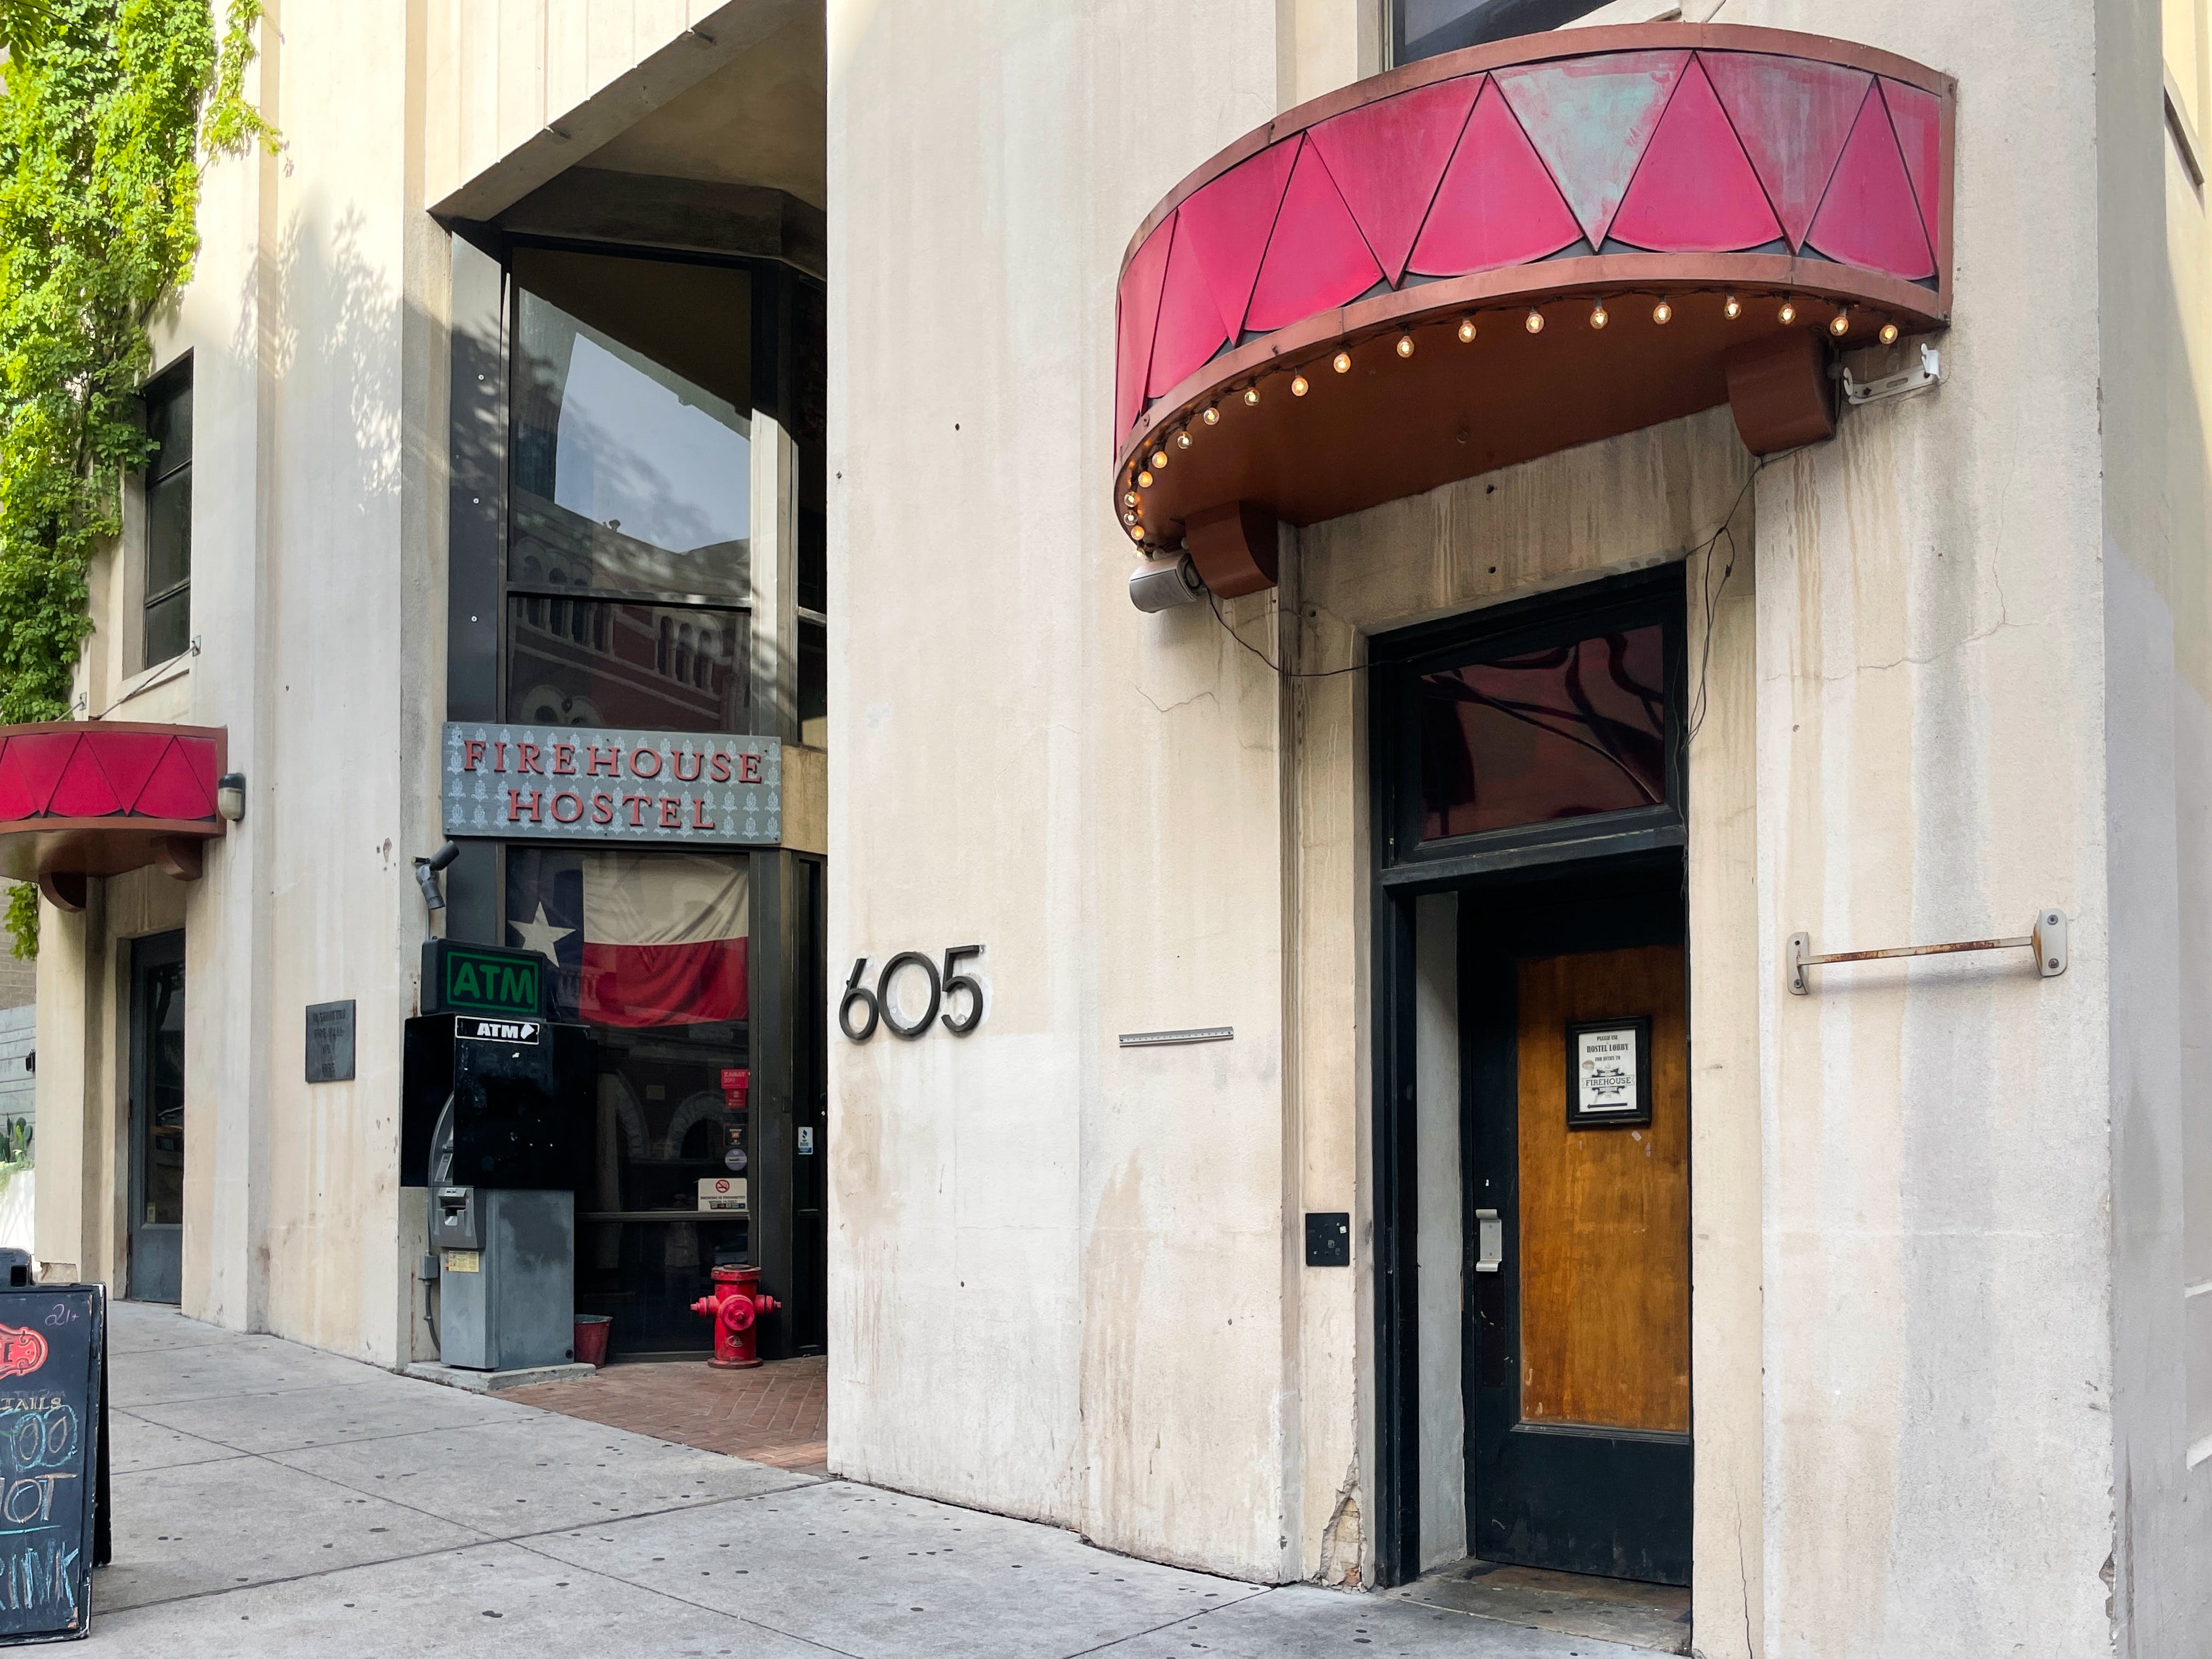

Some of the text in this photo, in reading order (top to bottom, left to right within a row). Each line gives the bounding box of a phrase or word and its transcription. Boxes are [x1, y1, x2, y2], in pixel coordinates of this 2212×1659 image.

[464, 740, 761, 783] FIREHOUSE
[507, 789, 715, 829] HOSTEL
[453, 962, 534, 1005] ATM
[839, 944, 983, 1040] 605
[477, 1023, 518, 1039] ATM
[1587, 1043, 1628, 1053] HOSTEL LOBBY
[1585, 1077, 1631, 1086] FIREHOUSE
[44, 1304, 80, 1326] 21+
[0, 1474, 78, 1522] OT
